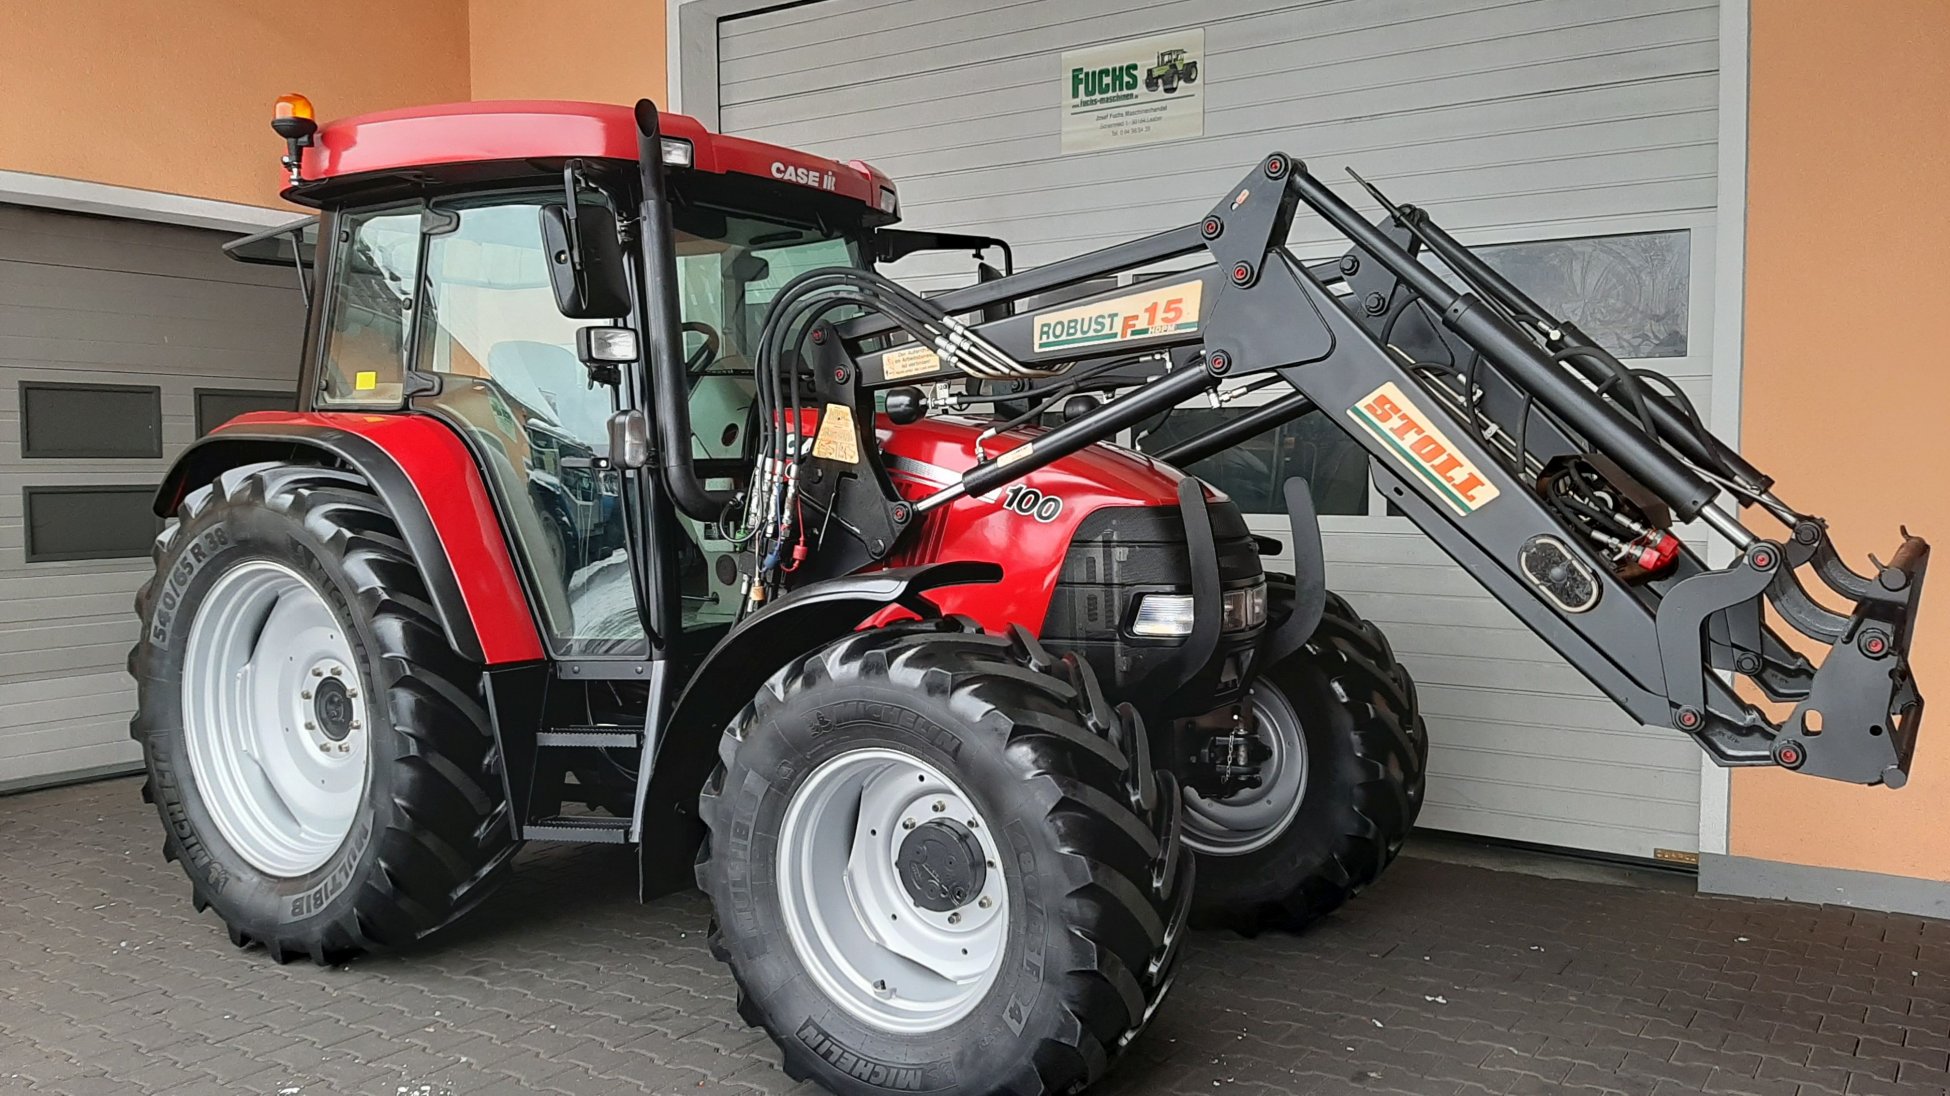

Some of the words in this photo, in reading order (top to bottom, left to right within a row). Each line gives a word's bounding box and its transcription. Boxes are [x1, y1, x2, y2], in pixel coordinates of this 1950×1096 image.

[1072, 63, 1138, 98] FUCHS
[771, 162, 819, 187] CASE
[1039, 313, 1118, 342] ROBUST
[1120, 315, 1139, 339] F
[1144, 298, 1183, 326] 15
[1363, 394, 1486, 503] STOLL
[1003, 484, 1063, 523] 100
[153, 556, 194, 643] 540/65
[190, 543, 207, 563] R
[204, 527, 228, 552] 38
[834, 700, 961, 752] MICHELIN
[291, 822, 370, 917] MULTIBIB
[800, 1025, 923, 1089] MICHELIN
